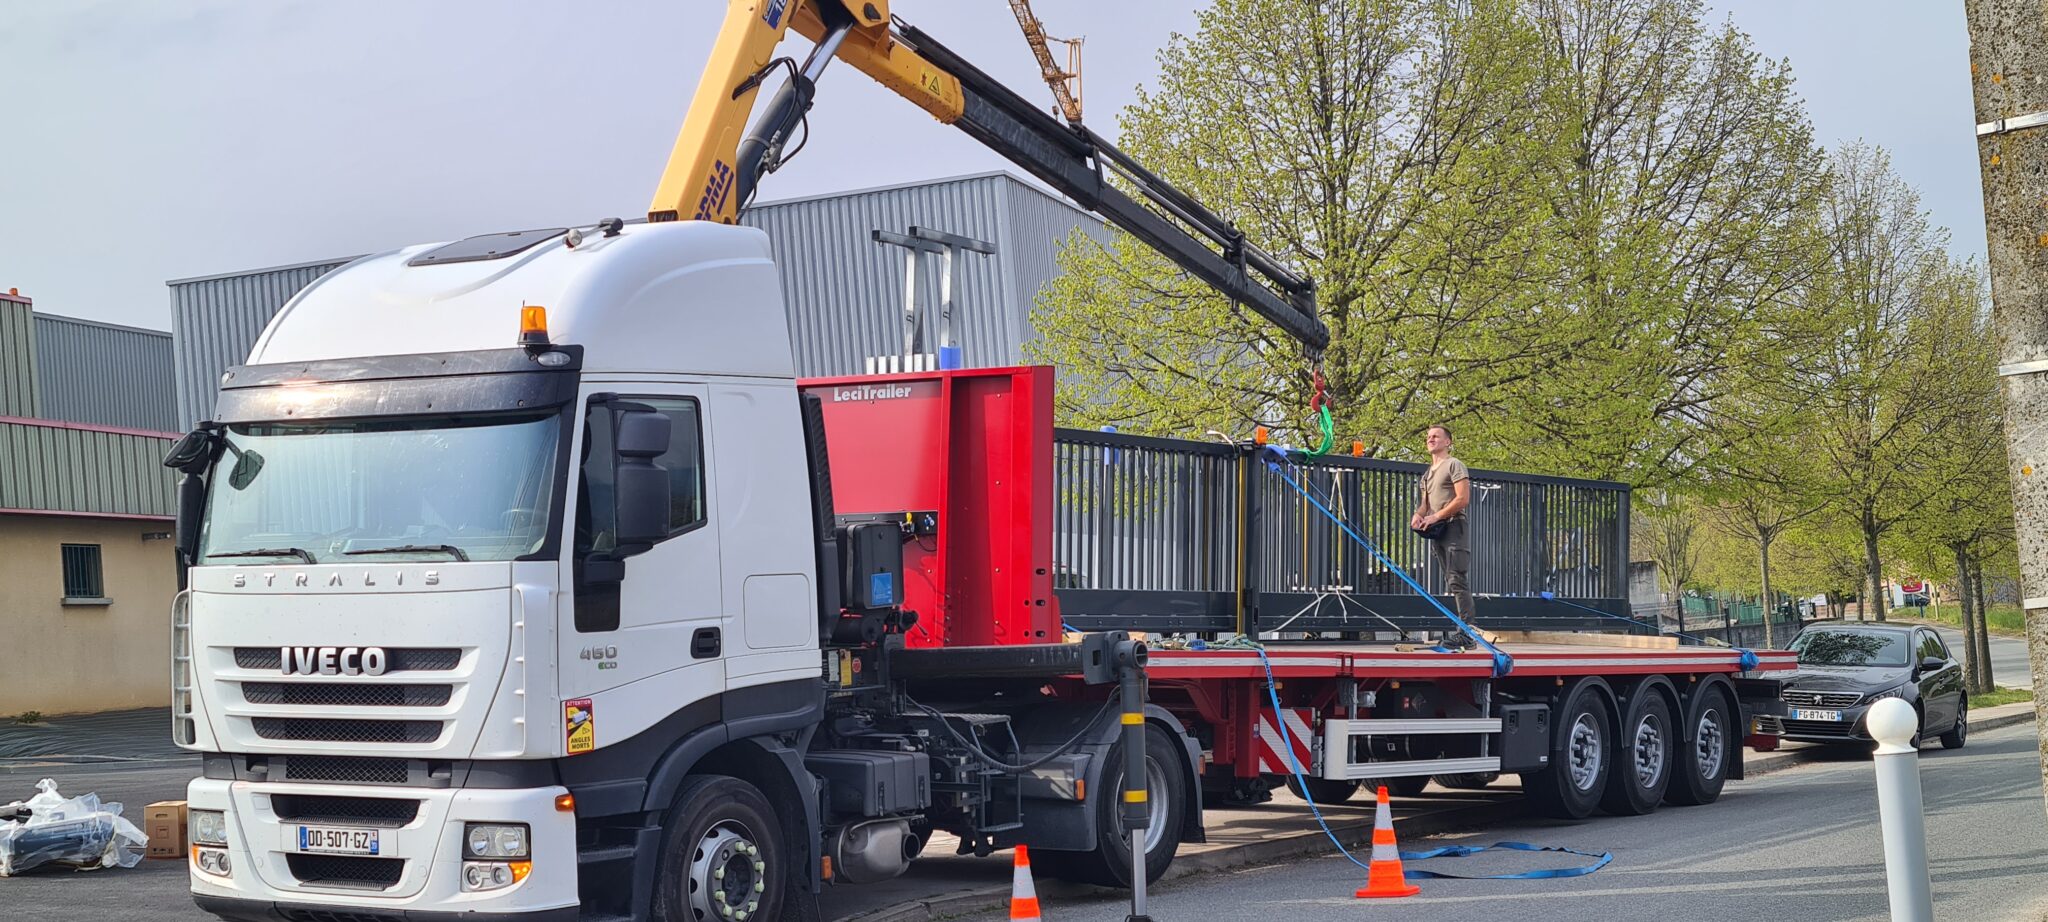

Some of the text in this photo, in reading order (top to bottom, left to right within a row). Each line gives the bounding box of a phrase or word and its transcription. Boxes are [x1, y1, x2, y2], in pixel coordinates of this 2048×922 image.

[833, 384, 911, 401] LeciTrailer
[233, 570, 440, 588] STRALIS
[580, 646, 617, 660] 460
[281, 647, 386, 676] IVECO
[598, 662, 617, 670] ECO
[570, 736, 591, 744] ANGLES
[571, 742, 590, 750] MORTS
[308, 830, 370, 849] DD-507-GZ
